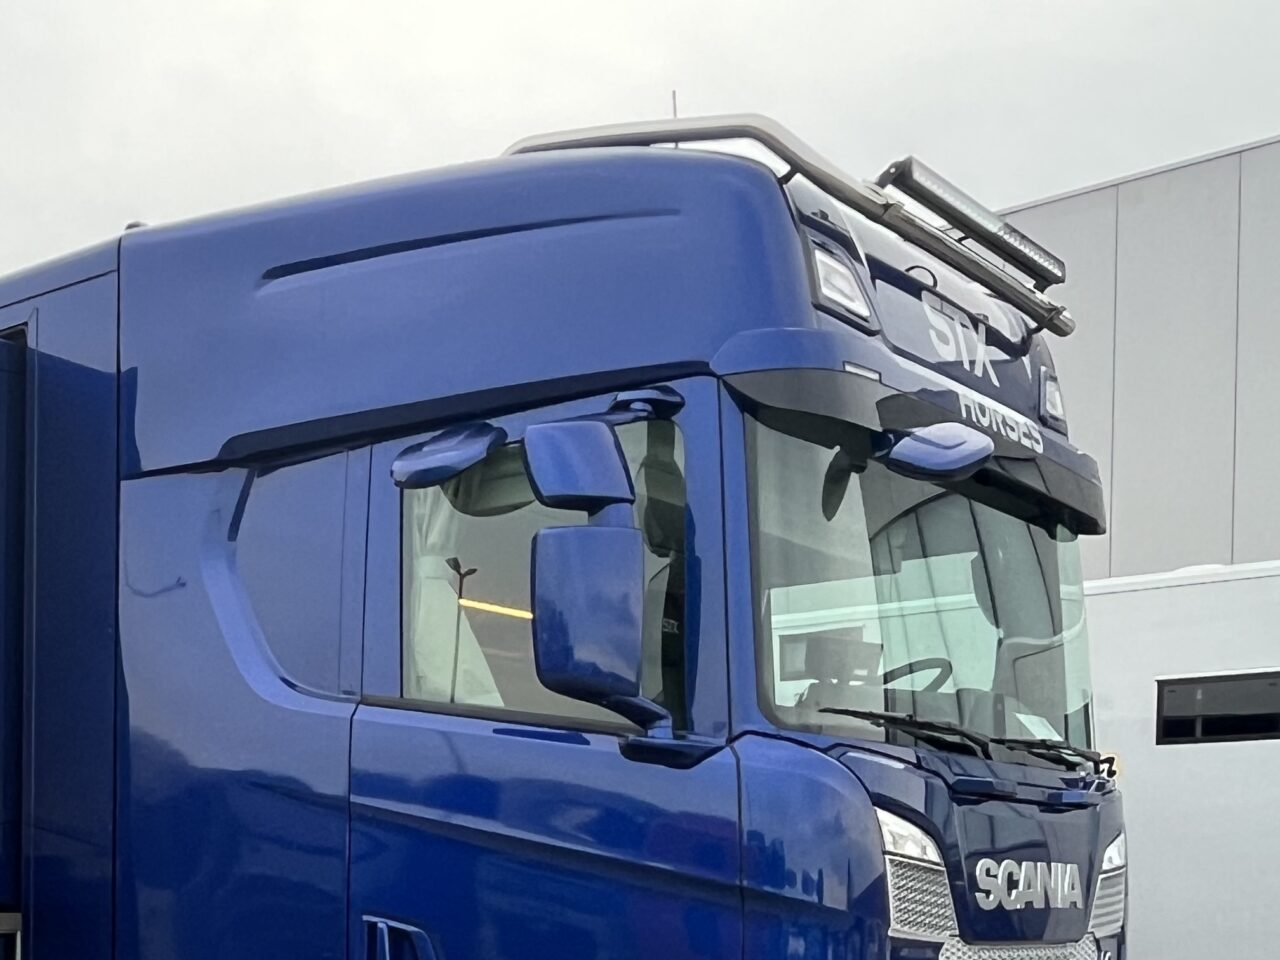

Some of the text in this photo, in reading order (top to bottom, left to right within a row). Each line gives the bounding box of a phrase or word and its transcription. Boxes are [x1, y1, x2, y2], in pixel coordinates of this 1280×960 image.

[922, 290, 1000, 388] STX
[957, 393, 1044, 454] HORSES
[975, 858, 1082, 911] SCANIA
